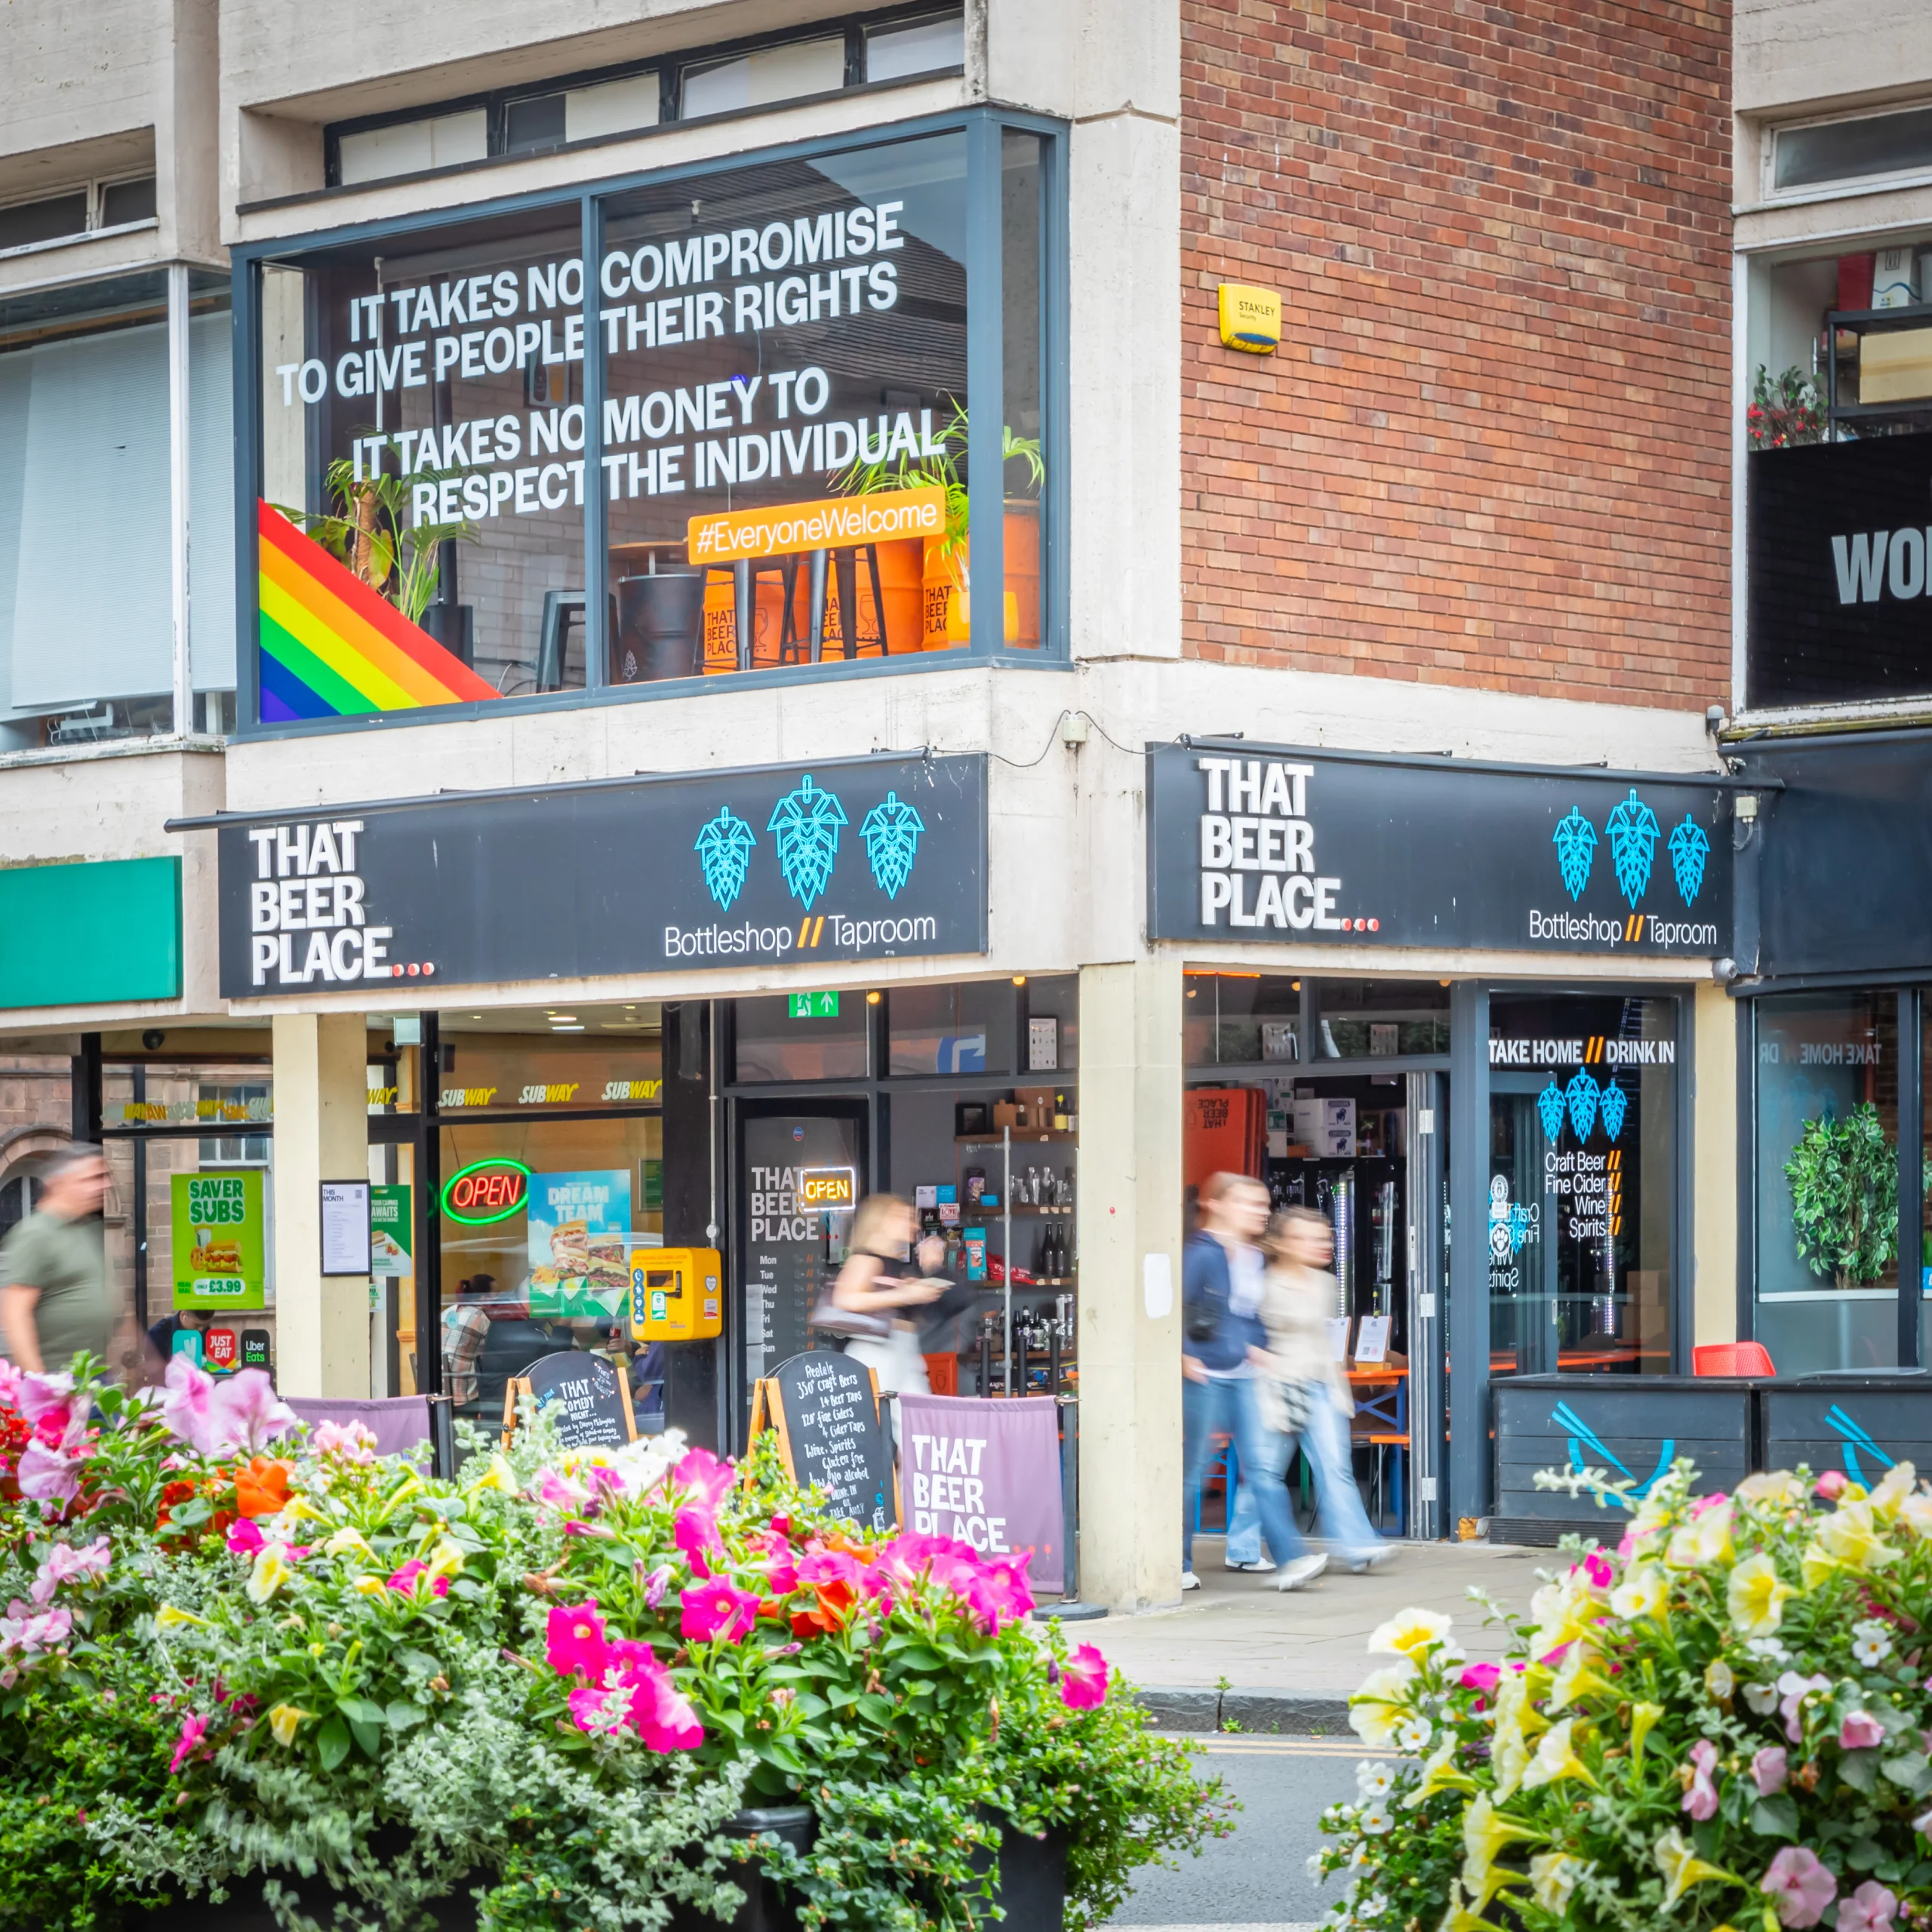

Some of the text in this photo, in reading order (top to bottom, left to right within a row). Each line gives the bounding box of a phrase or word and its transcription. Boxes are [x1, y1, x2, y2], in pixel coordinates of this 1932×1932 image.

[349, 200, 905, 343] IT TAKES NO COMPROMISE
[1238, 300, 1275, 317] STANLEY
[275, 261, 898, 408] TO GIVE PEOPLE THEIR RIGHTS
[352, 366, 830, 483] IT TAKES NO MONEY TO
[412, 408, 946, 528] RESPECT THE INDIVIDUAL
[696, 502, 938, 555] #EveryoneWelcome
[925, 586, 952, 604] THAT
[706, 608, 735, 626] THAT
[706, 624, 737, 642] BEER
[706, 638, 737, 657] PLAC
[1198, 757, 1315, 817] THAT
[249, 820, 364, 879] THAT
[1201, 814, 1315, 873] BEER
[251, 875, 365, 933] BEER
[665, 922, 792, 957] Bottleshop
[828, 914, 936, 952] Taproom
[1529, 909, 1622, 948] Bottleshop
[1646, 914, 1717, 949] Taproom
[1488, 1039, 1530, 1064] TAKE
[1532, 1039, 1583, 1064] HOME
[1605, 1040, 1657, 1064] DRINK
[1658, 1040, 1675, 1064] IN
[367, 1078, 663, 1108] WAY SUBWAY SUBWAY SUBWAY
[1545, 1151, 1576, 1172] Craft
[1577, 1151, 1606, 1171] Beer
[189, 1179, 244, 1199] SAVER
[752, 1167, 801, 1191] THAT
[1546, 1174, 1571, 1194] Fine
[1573, 1173, 1606, 1194] Cider
[453, 1174, 521, 1208] OPEN
[547, 1185, 610, 1206] DREAM
[804, 1180, 849, 1200] OPEN
[189, 1200, 245, 1224] SUBS
[371, 1206, 398, 1217] AWAITS
[555, 1204, 604, 1223] TEAM
[1574, 1195, 1606, 1216] Wine
[1569, 1217, 1606, 1242] Spirits
[759, 1255, 777, 1265] Mon
[759, 1270, 774, 1280] Tue
[209, 1280, 242, 1293] £3.99
[761, 1284, 777, 1294] Wed
[761, 1299, 775, 1309] Thu
[210, 1335, 232, 1349] JUST
[760, 1328, 774, 1338] Sat
[214, 1346, 232, 1359] EAT
[245, 1340, 265, 1352] Uber
[760, 1343, 775, 1352] Sun
[246, 1352, 266, 1362] Eats
[559, 1378, 589, 1400] THAT
[838, 1374, 858, 1389] Beers
[829, 1393, 844, 1407] Beer
[845, 1391, 863, 1403] Taps
[832, 1407, 854, 1421] Ciders
[829, 1423, 848, 1438] Cider
[847, 1421, 866, 1433] Taps
[829, 1437, 857, 1454] Spirits
[911, 1434, 987, 1475] THAT
[822, 1454, 849, 1469] Gluten
[831, 1471, 842, 1486] No
[844, 1467, 869, 1482] alcohol
[912, 1472, 986, 1514] BEER
